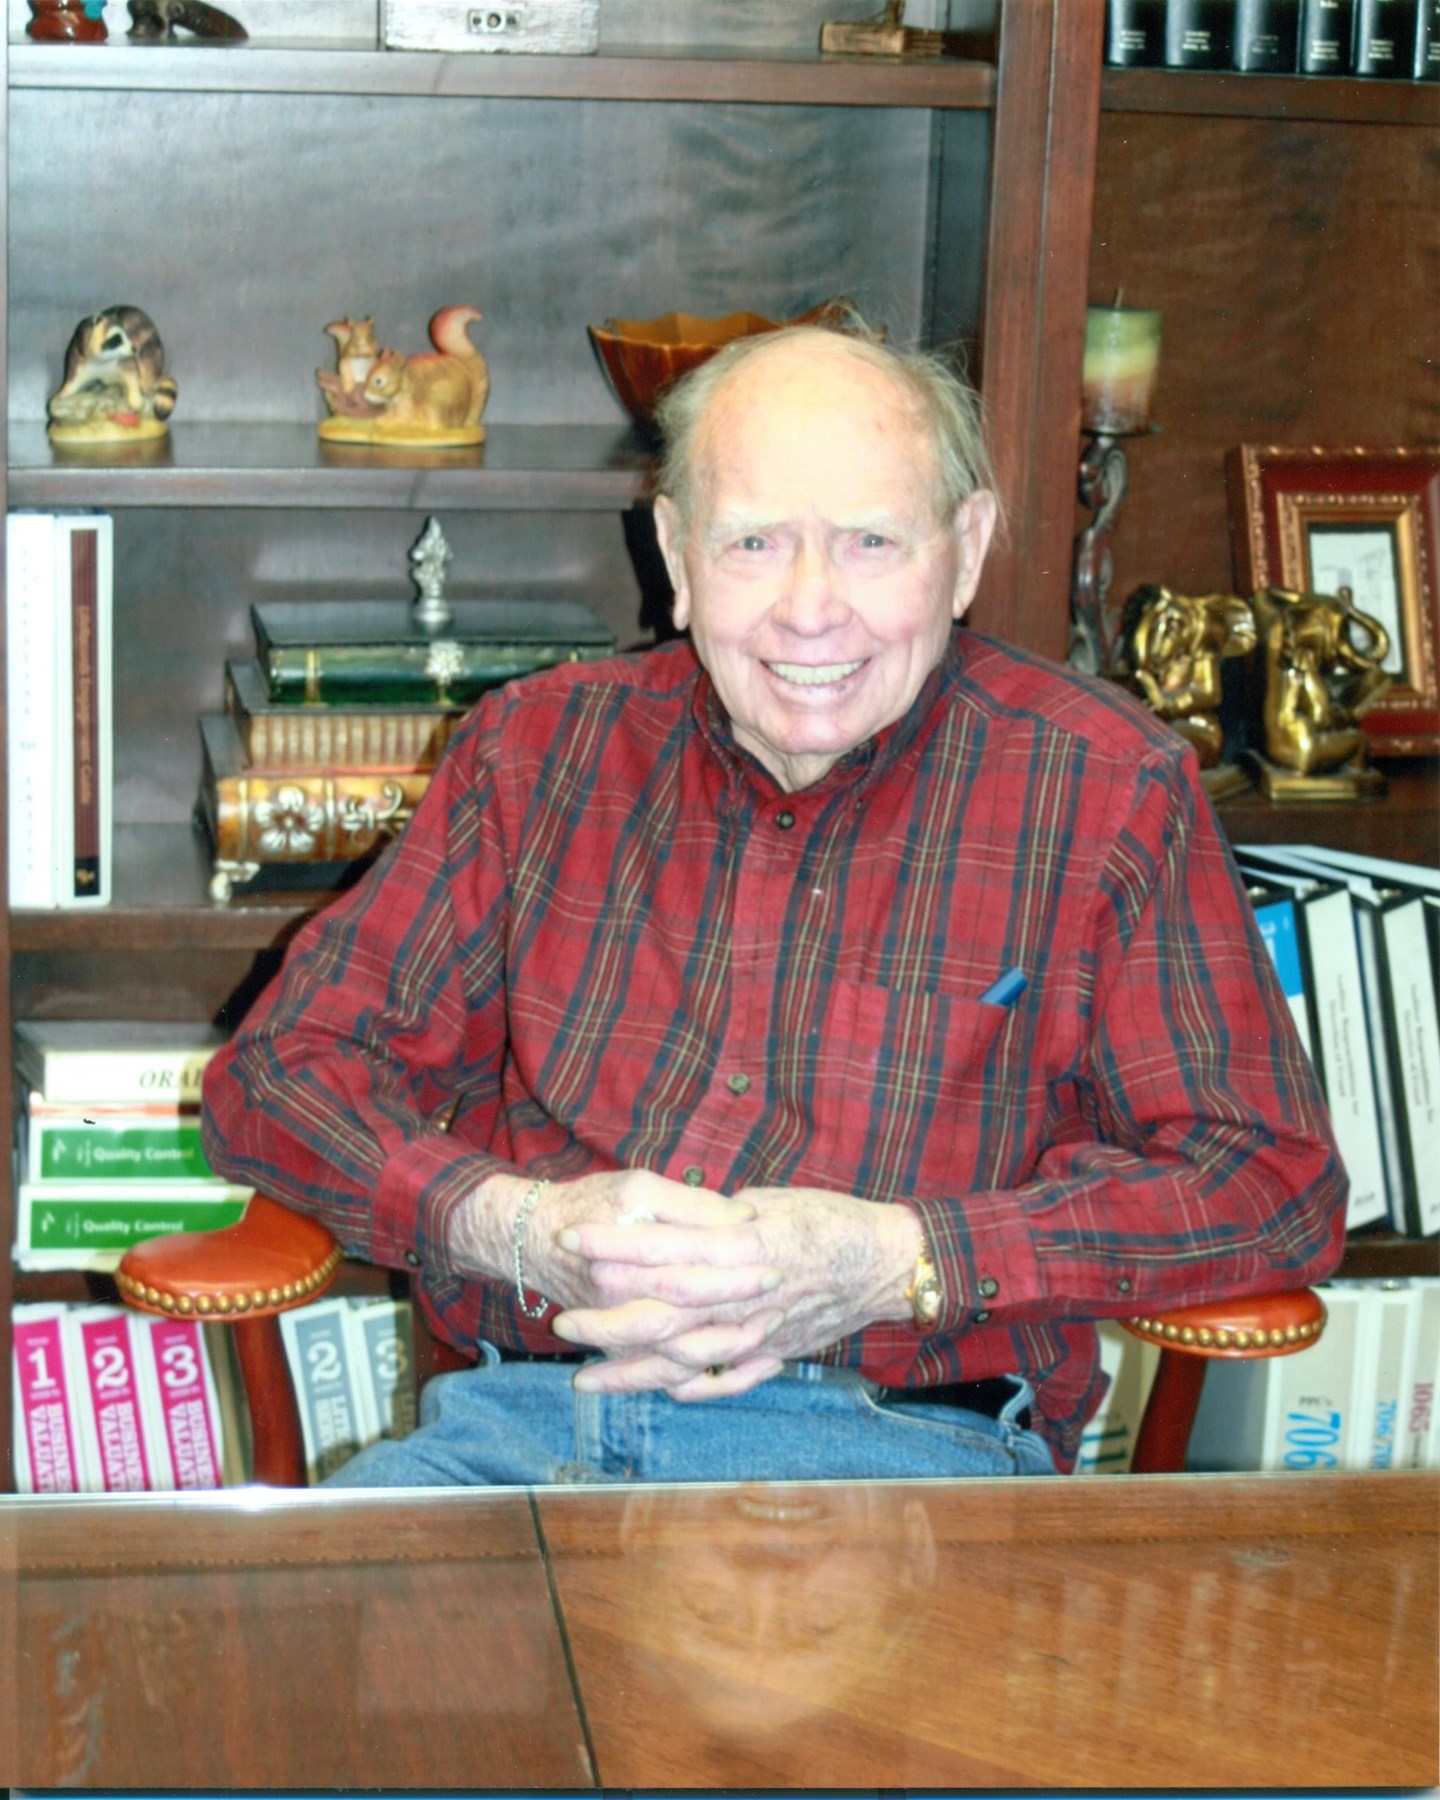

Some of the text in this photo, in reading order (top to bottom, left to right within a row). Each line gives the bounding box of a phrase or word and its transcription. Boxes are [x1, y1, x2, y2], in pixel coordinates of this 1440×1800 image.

[94, 1147, 194, 1162] Quality Control
[83, 1219, 184, 1234] Quality Control
[27, 1347, 57, 1390] 1
[93, 1345, 130, 1391] 2
[161, 1344, 199, 1389] 3
[306, 1340, 342, 1385] 2
[375, 1337, 408, 1380] 3
[1283, 1411, 1341, 1469] 706
